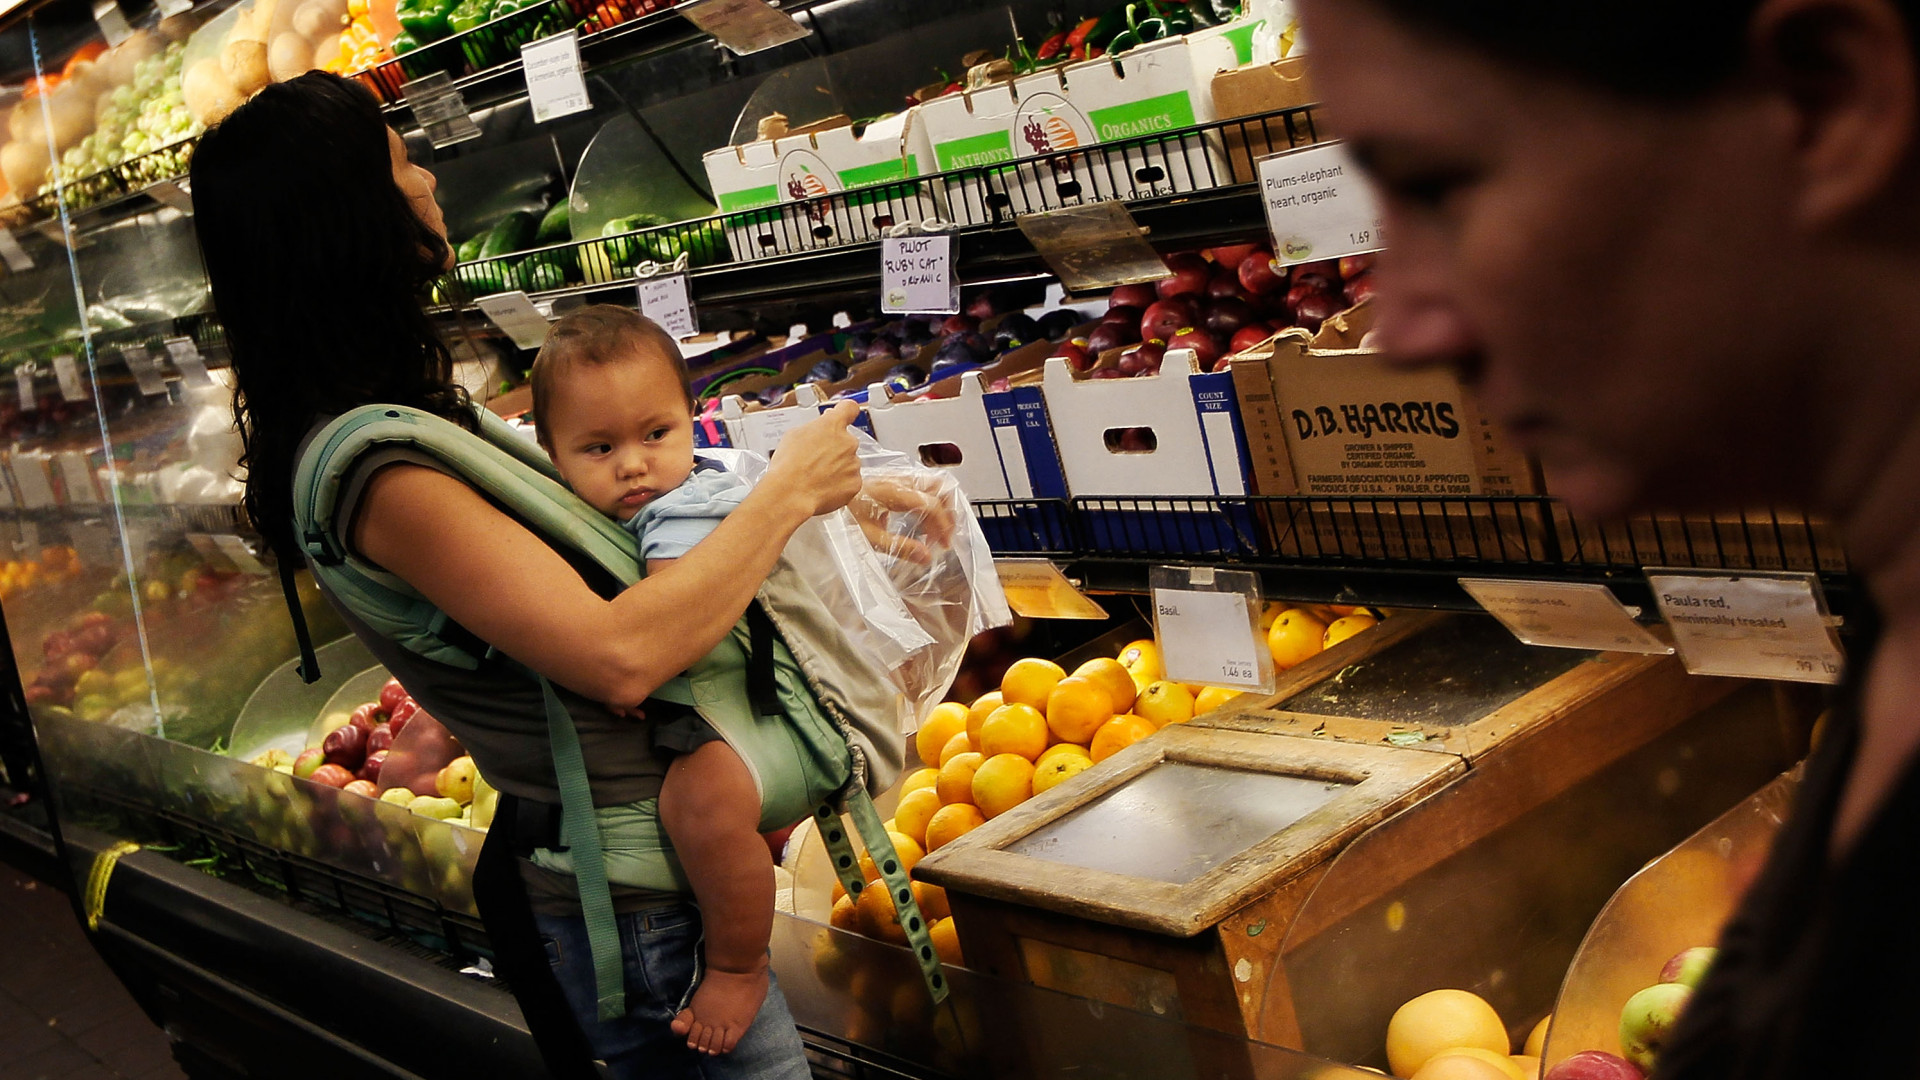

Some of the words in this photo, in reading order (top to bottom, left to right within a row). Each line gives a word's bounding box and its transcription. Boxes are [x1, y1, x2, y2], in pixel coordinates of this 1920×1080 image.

[1102, 114, 1172, 140] ORGANICS
[1266, 165, 1343, 190] Plums-elephant
[1270, 195, 1300, 210] heart,
[1301, 186, 1338, 205] organic
[1350, 230, 1370, 245] 1.69
[1198, 391, 1225, 400] COUNT
[1205, 402, 1223, 410] SIZE
[1340, 401, 1459, 439] HARRIS
[1344, 443, 1376, 451] GROWER
[1383, 443, 1414, 451] SHIPPER
[1346, 452, 1382, 460] CERTIFIED
[1383, 452, 1415, 460] ORGANIC
[1341, 461, 1350, 469] BY
[1351, 461, 1383, 469] ORGANIC
[1385, 460, 1426, 468] CERTIFIERS
[1307, 475, 1345, 483] FARMERS
[1345, 475, 1398, 483] ASSOCIATION
[1424, 474, 1470, 483] APPROVED
[1362, 485, 1385, 493] U.S.A.
[1396, 485, 1432, 494] PARLIER,
[1433, 485, 1446, 493] CA
[1664, 594, 1701, 607] Paula
[1702, 596, 1731, 609] red,
[1672, 613, 1735, 627] minimally
[1736, 615, 1787, 628] treated
[1222, 666, 1239, 677] 1.46
[1242, 669, 1252, 678] ea
